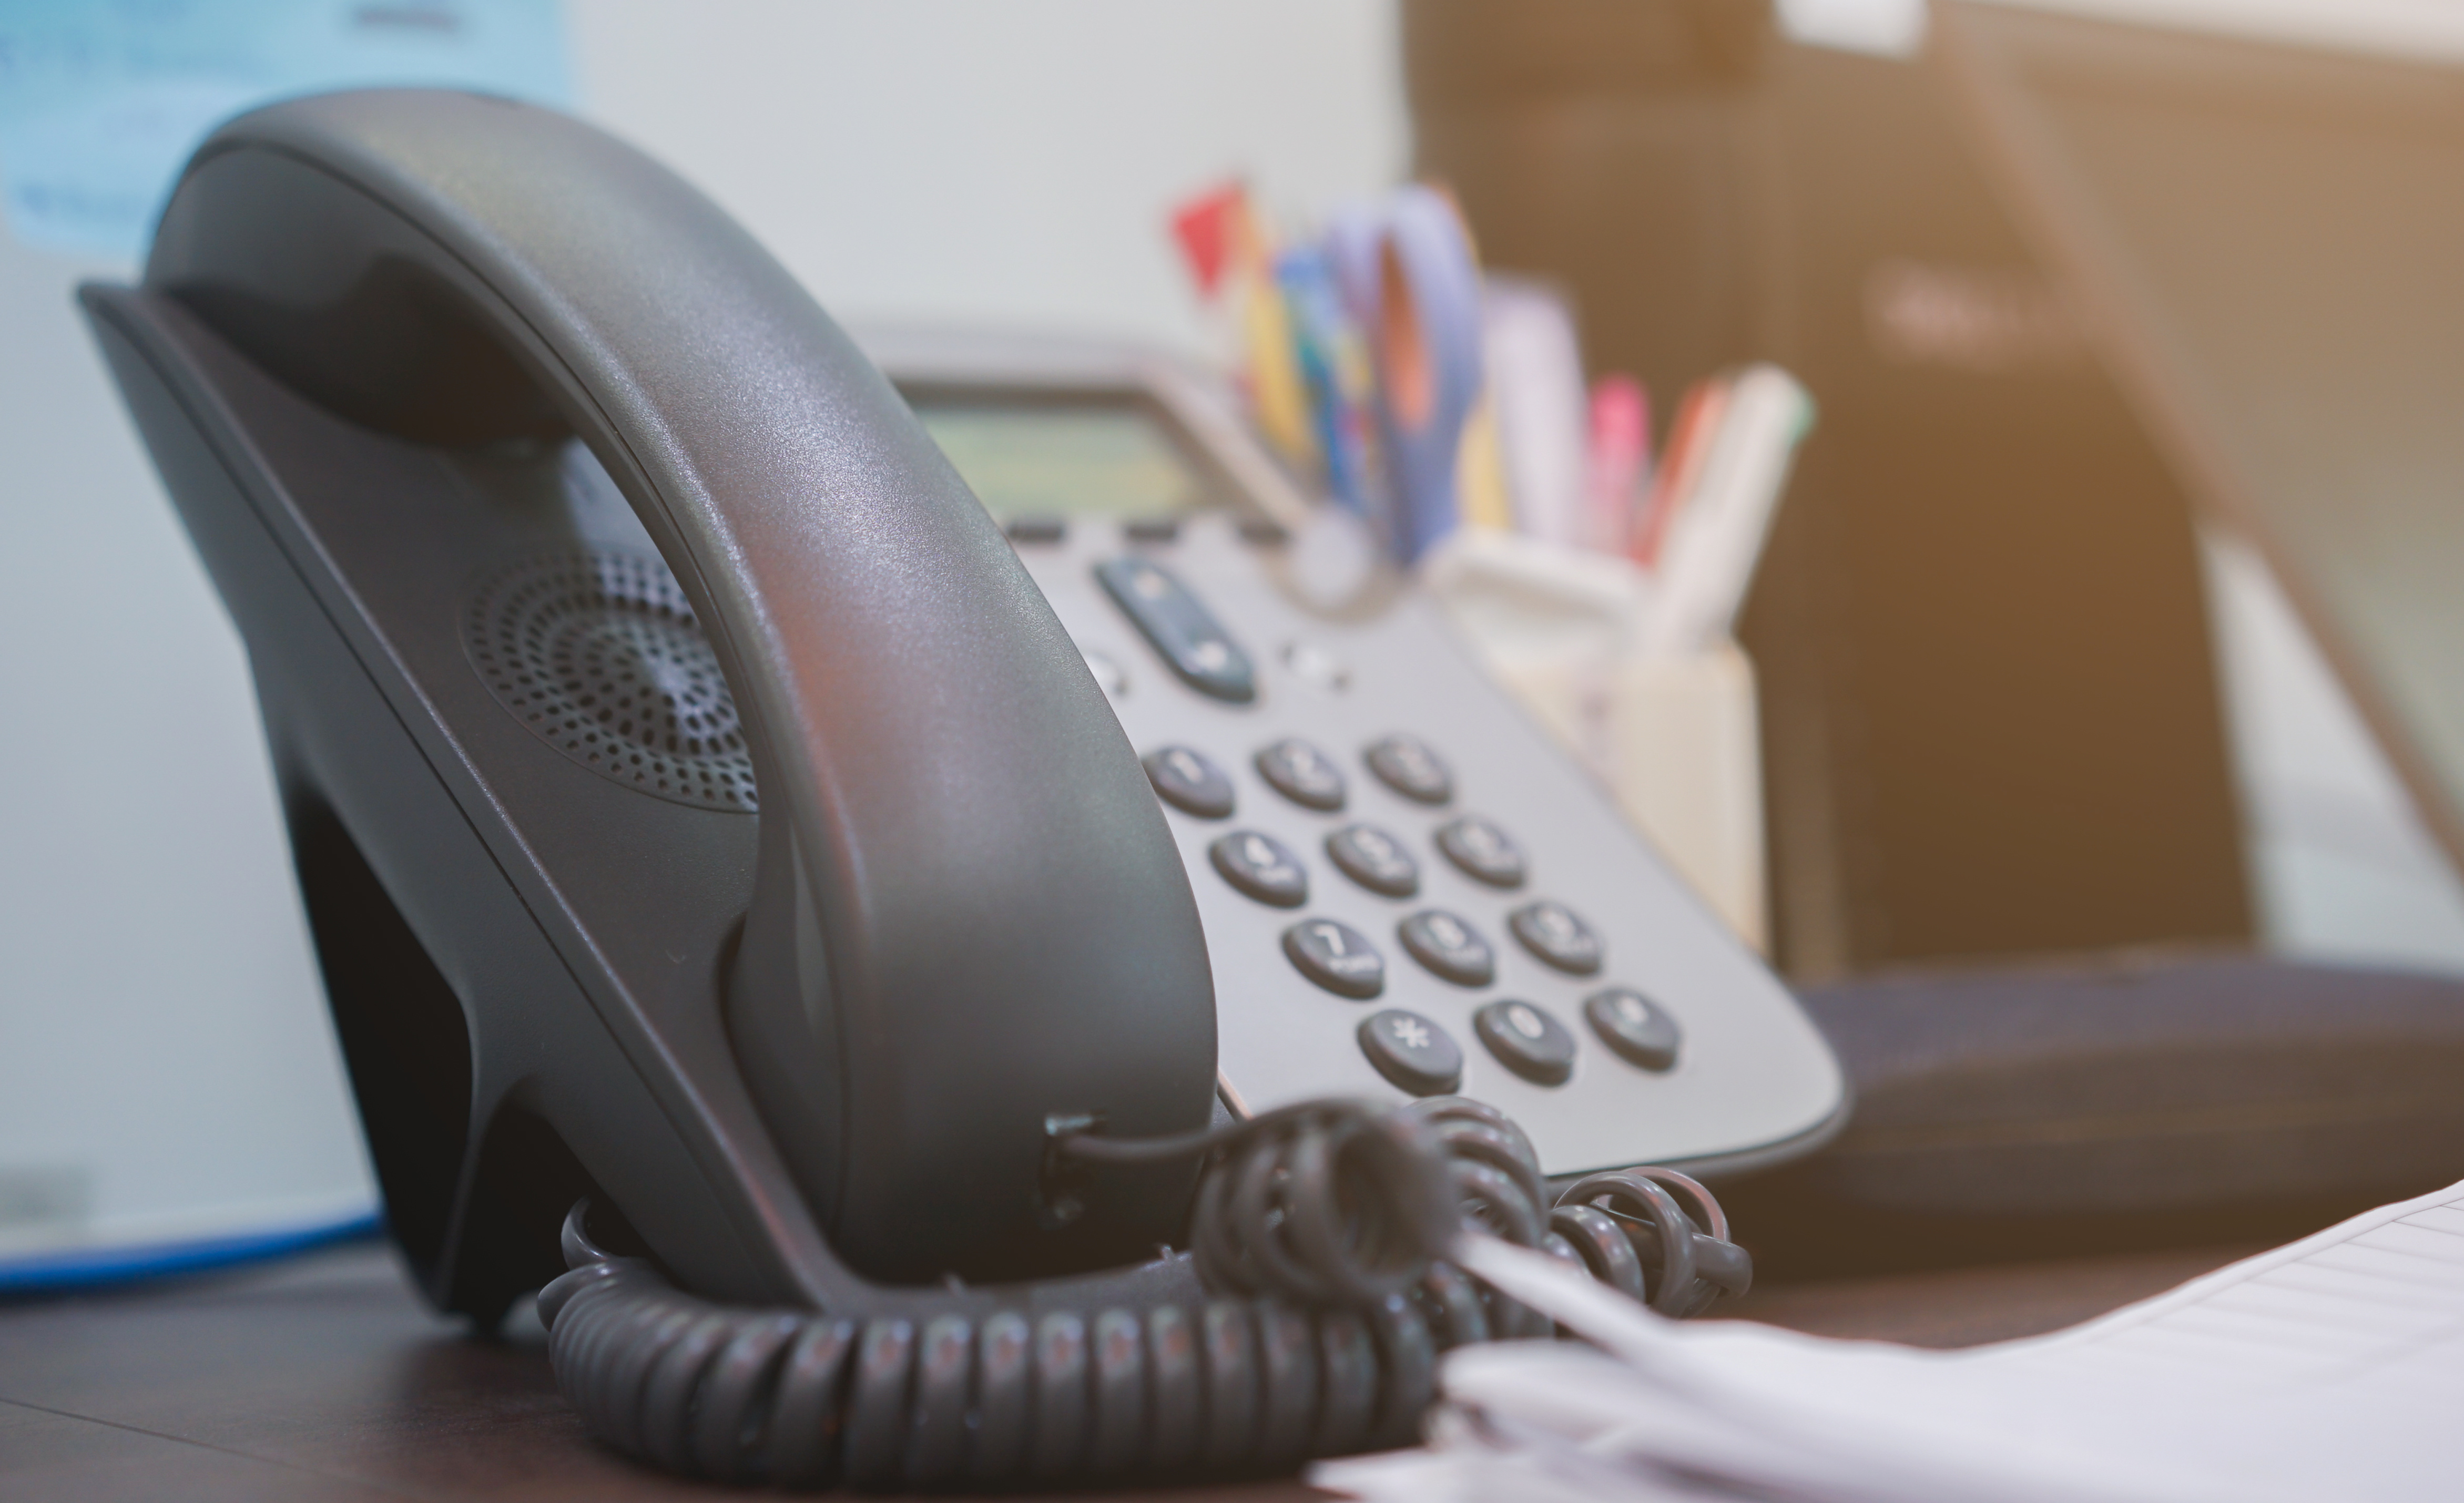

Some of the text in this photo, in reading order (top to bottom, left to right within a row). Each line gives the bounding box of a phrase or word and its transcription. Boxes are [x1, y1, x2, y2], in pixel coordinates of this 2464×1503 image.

[1167, 749, 1203, 783] 1
[1245, 836, 1275, 865] 4
[1314, 924, 1345, 956] 7
[1508, 1005, 1544, 1039] 0
